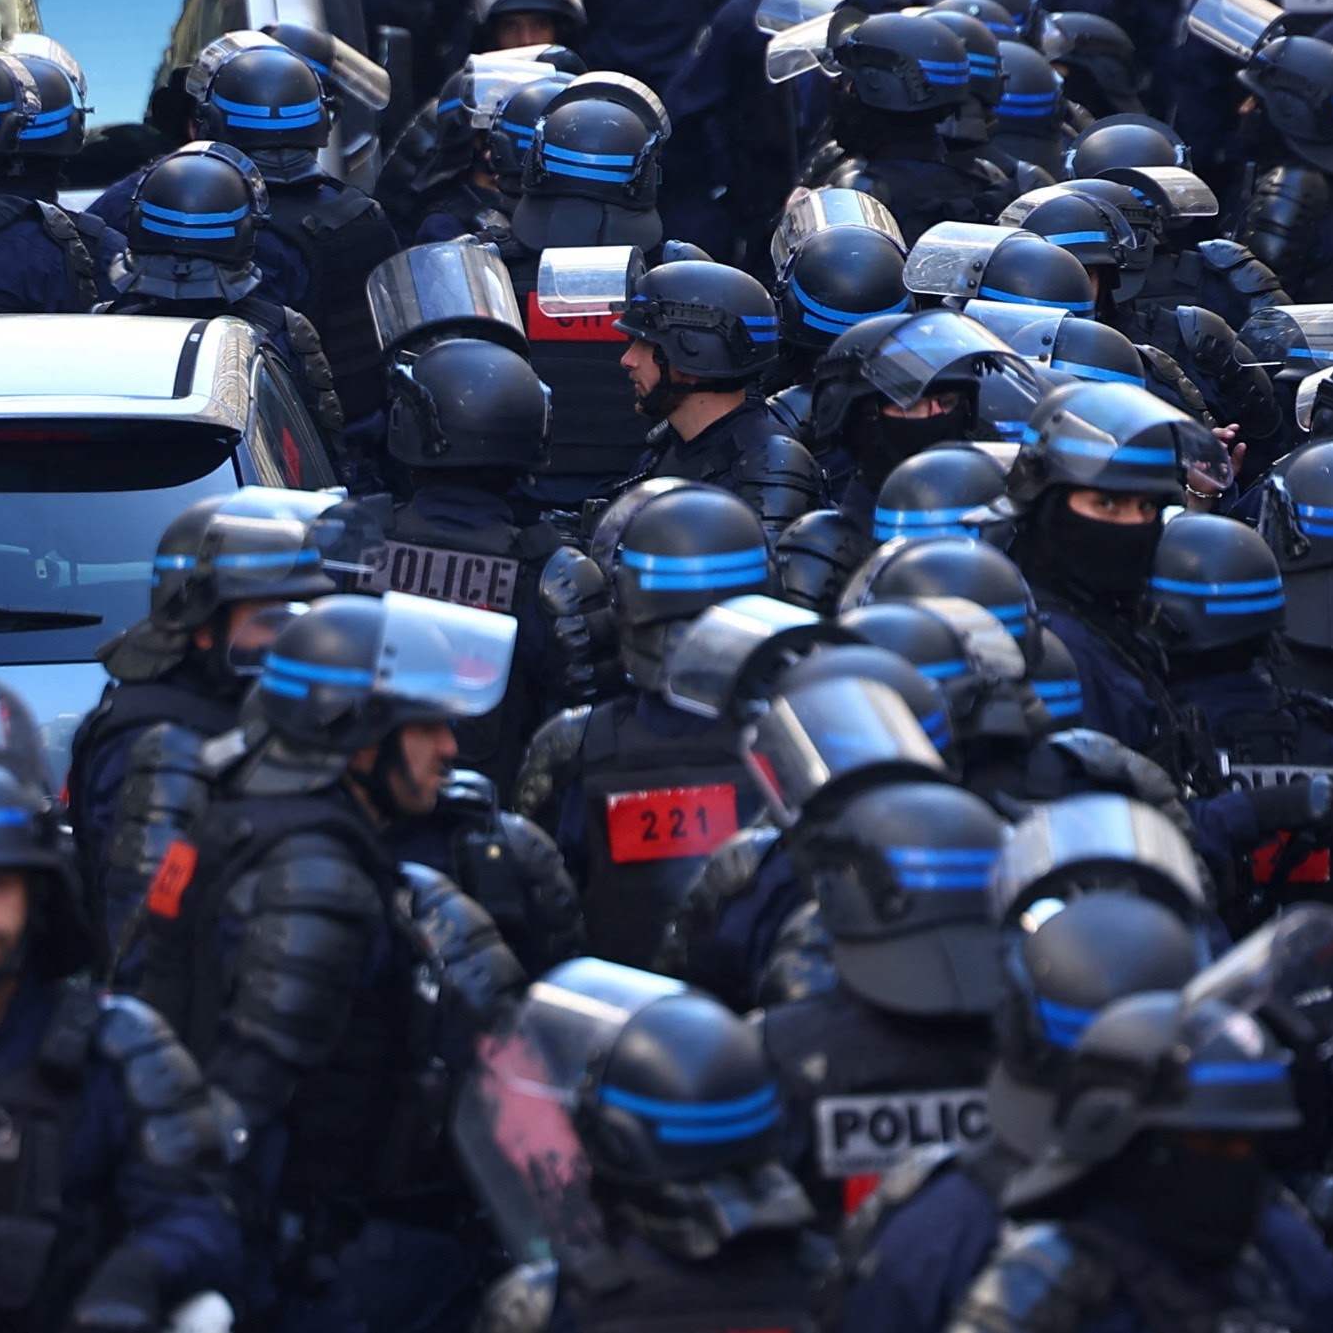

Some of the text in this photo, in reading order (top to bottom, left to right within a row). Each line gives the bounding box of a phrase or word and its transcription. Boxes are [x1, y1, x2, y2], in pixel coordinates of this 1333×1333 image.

[361, 547, 512, 605] POLICE
[641, 806, 709, 841] 221
[834, 1100, 993, 1151] POLIC
